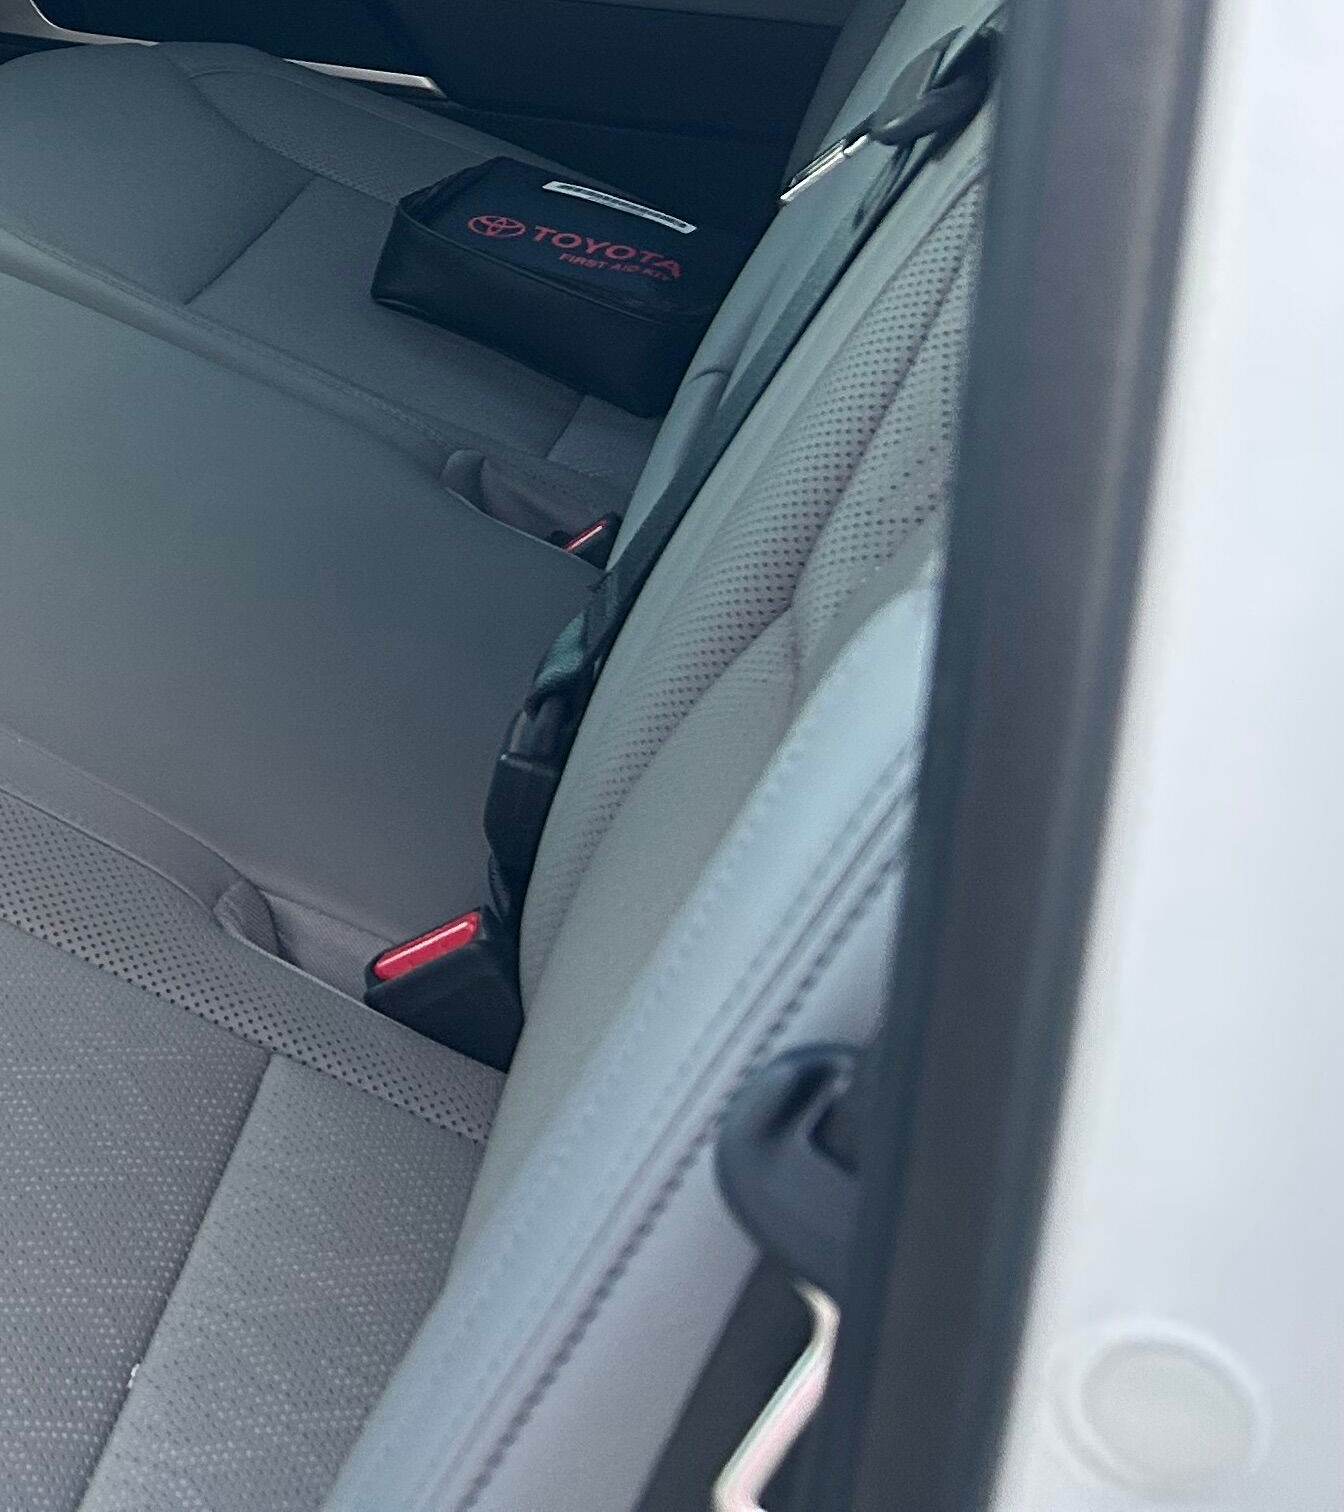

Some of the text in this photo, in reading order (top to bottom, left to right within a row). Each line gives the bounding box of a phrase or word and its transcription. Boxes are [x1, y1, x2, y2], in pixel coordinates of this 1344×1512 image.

[534, 224, 682, 280] TOYOTA
[559, 253, 609, 270] FIRST
[610, 262, 641, 274] AID
